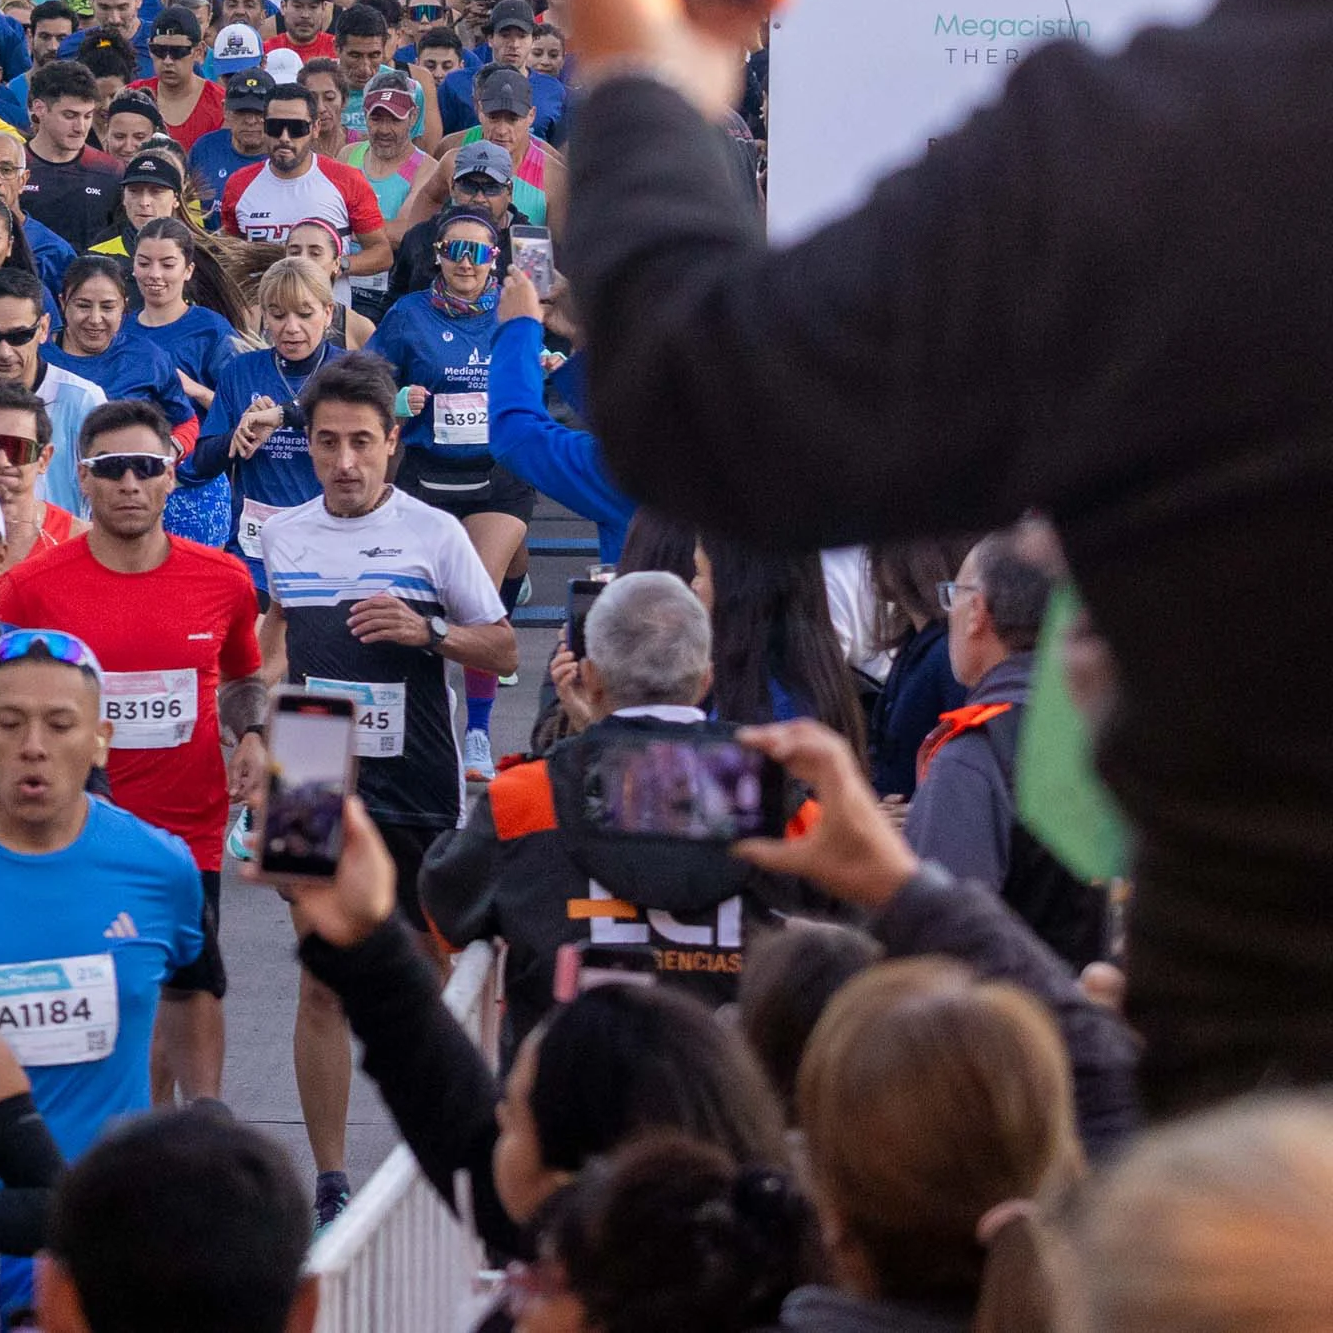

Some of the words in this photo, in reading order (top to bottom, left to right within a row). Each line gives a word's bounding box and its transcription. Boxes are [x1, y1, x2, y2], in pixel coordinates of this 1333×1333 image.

[944, 48, 1021, 65] THER
[444, 366, 489, 377] MediaMa
[444, 412, 487, 426] B392
[106, 699, 182, 720] B3196
